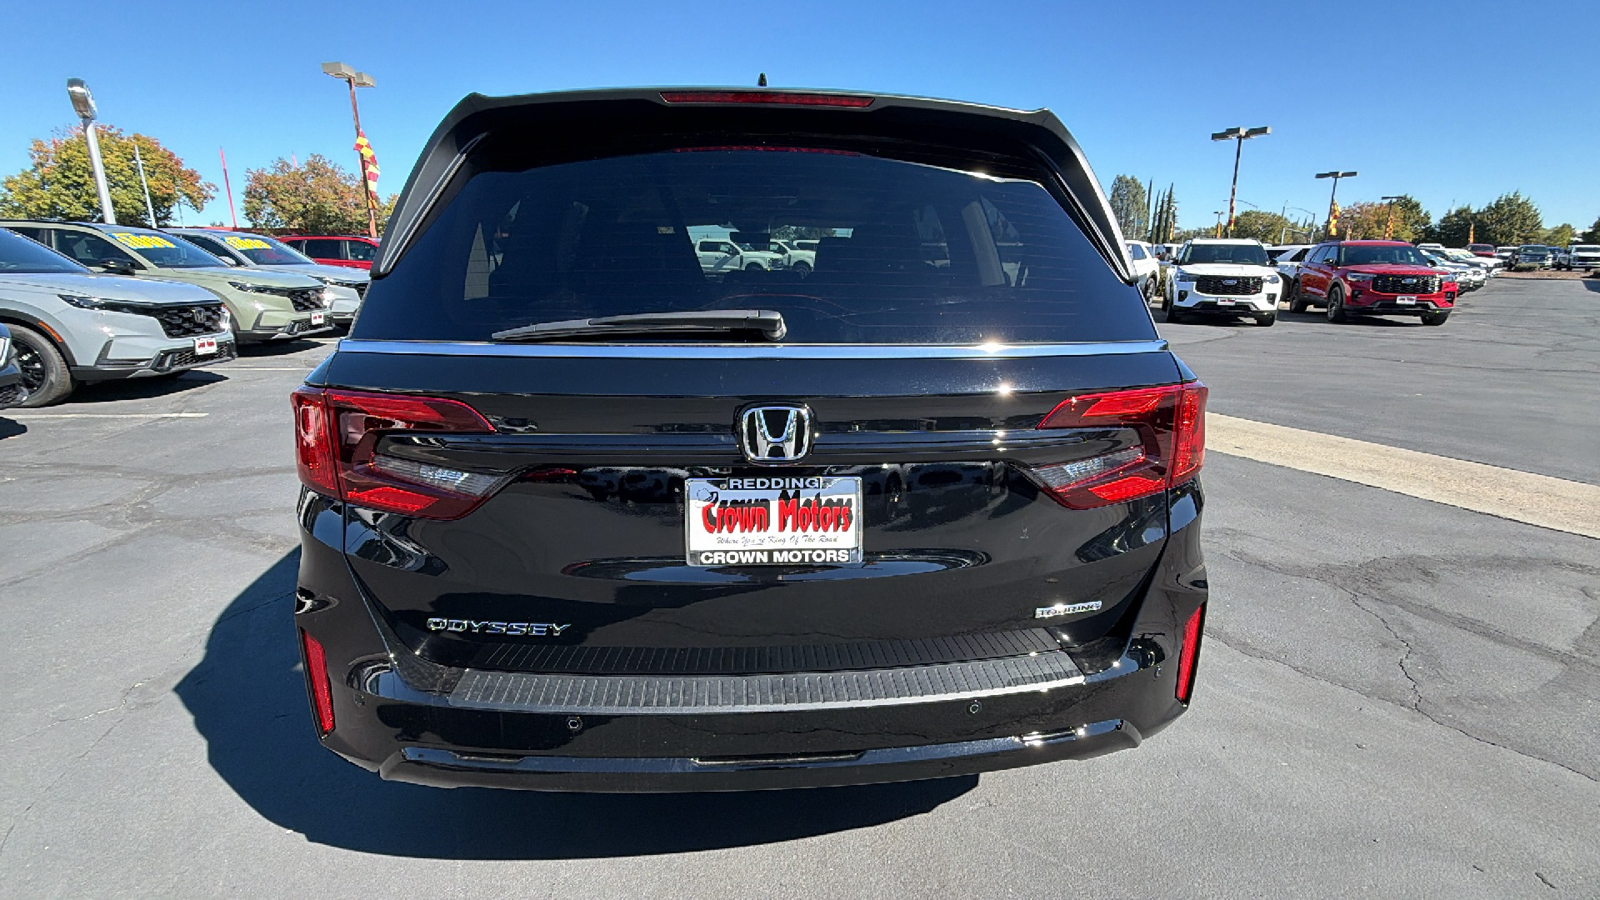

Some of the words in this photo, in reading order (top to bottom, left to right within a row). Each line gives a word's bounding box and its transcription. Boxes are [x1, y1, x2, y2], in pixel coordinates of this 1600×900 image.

[729, 478, 819, 489] REDDING
[702, 502, 769, 534] Crown
[778, 498, 851, 533] Motors
[716, 536, 739, 545] Where
[768, 535, 786, 545] King
[789, 534, 799, 545] Of
[802, 534, 816, 543] The
[818, 534, 838, 543] Road
[701, 551, 769, 564] CROWN
[772, 549, 850, 563] MOTORS
[1037, 602, 1101, 617] TOURING
[426, 618, 571, 636] ODYSSEY
